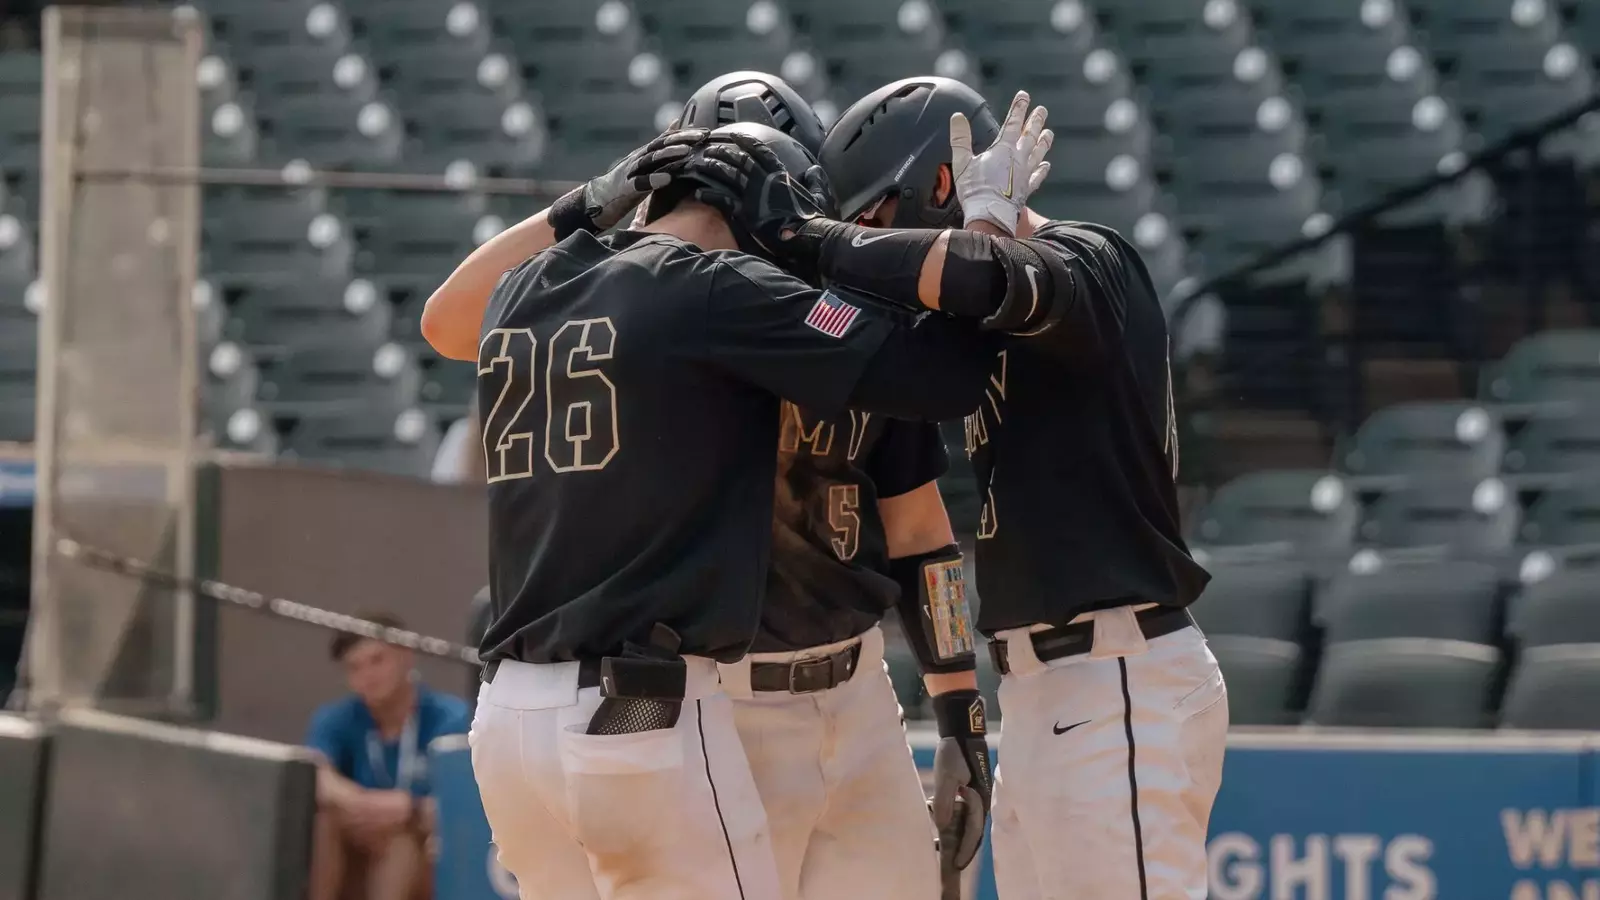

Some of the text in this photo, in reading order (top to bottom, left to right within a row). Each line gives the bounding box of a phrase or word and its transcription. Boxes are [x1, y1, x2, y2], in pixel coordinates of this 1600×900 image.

[477, 316, 620, 484] 26
[828, 484, 860, 561] 5
[1206, 831, 1438, 900] GHTS
